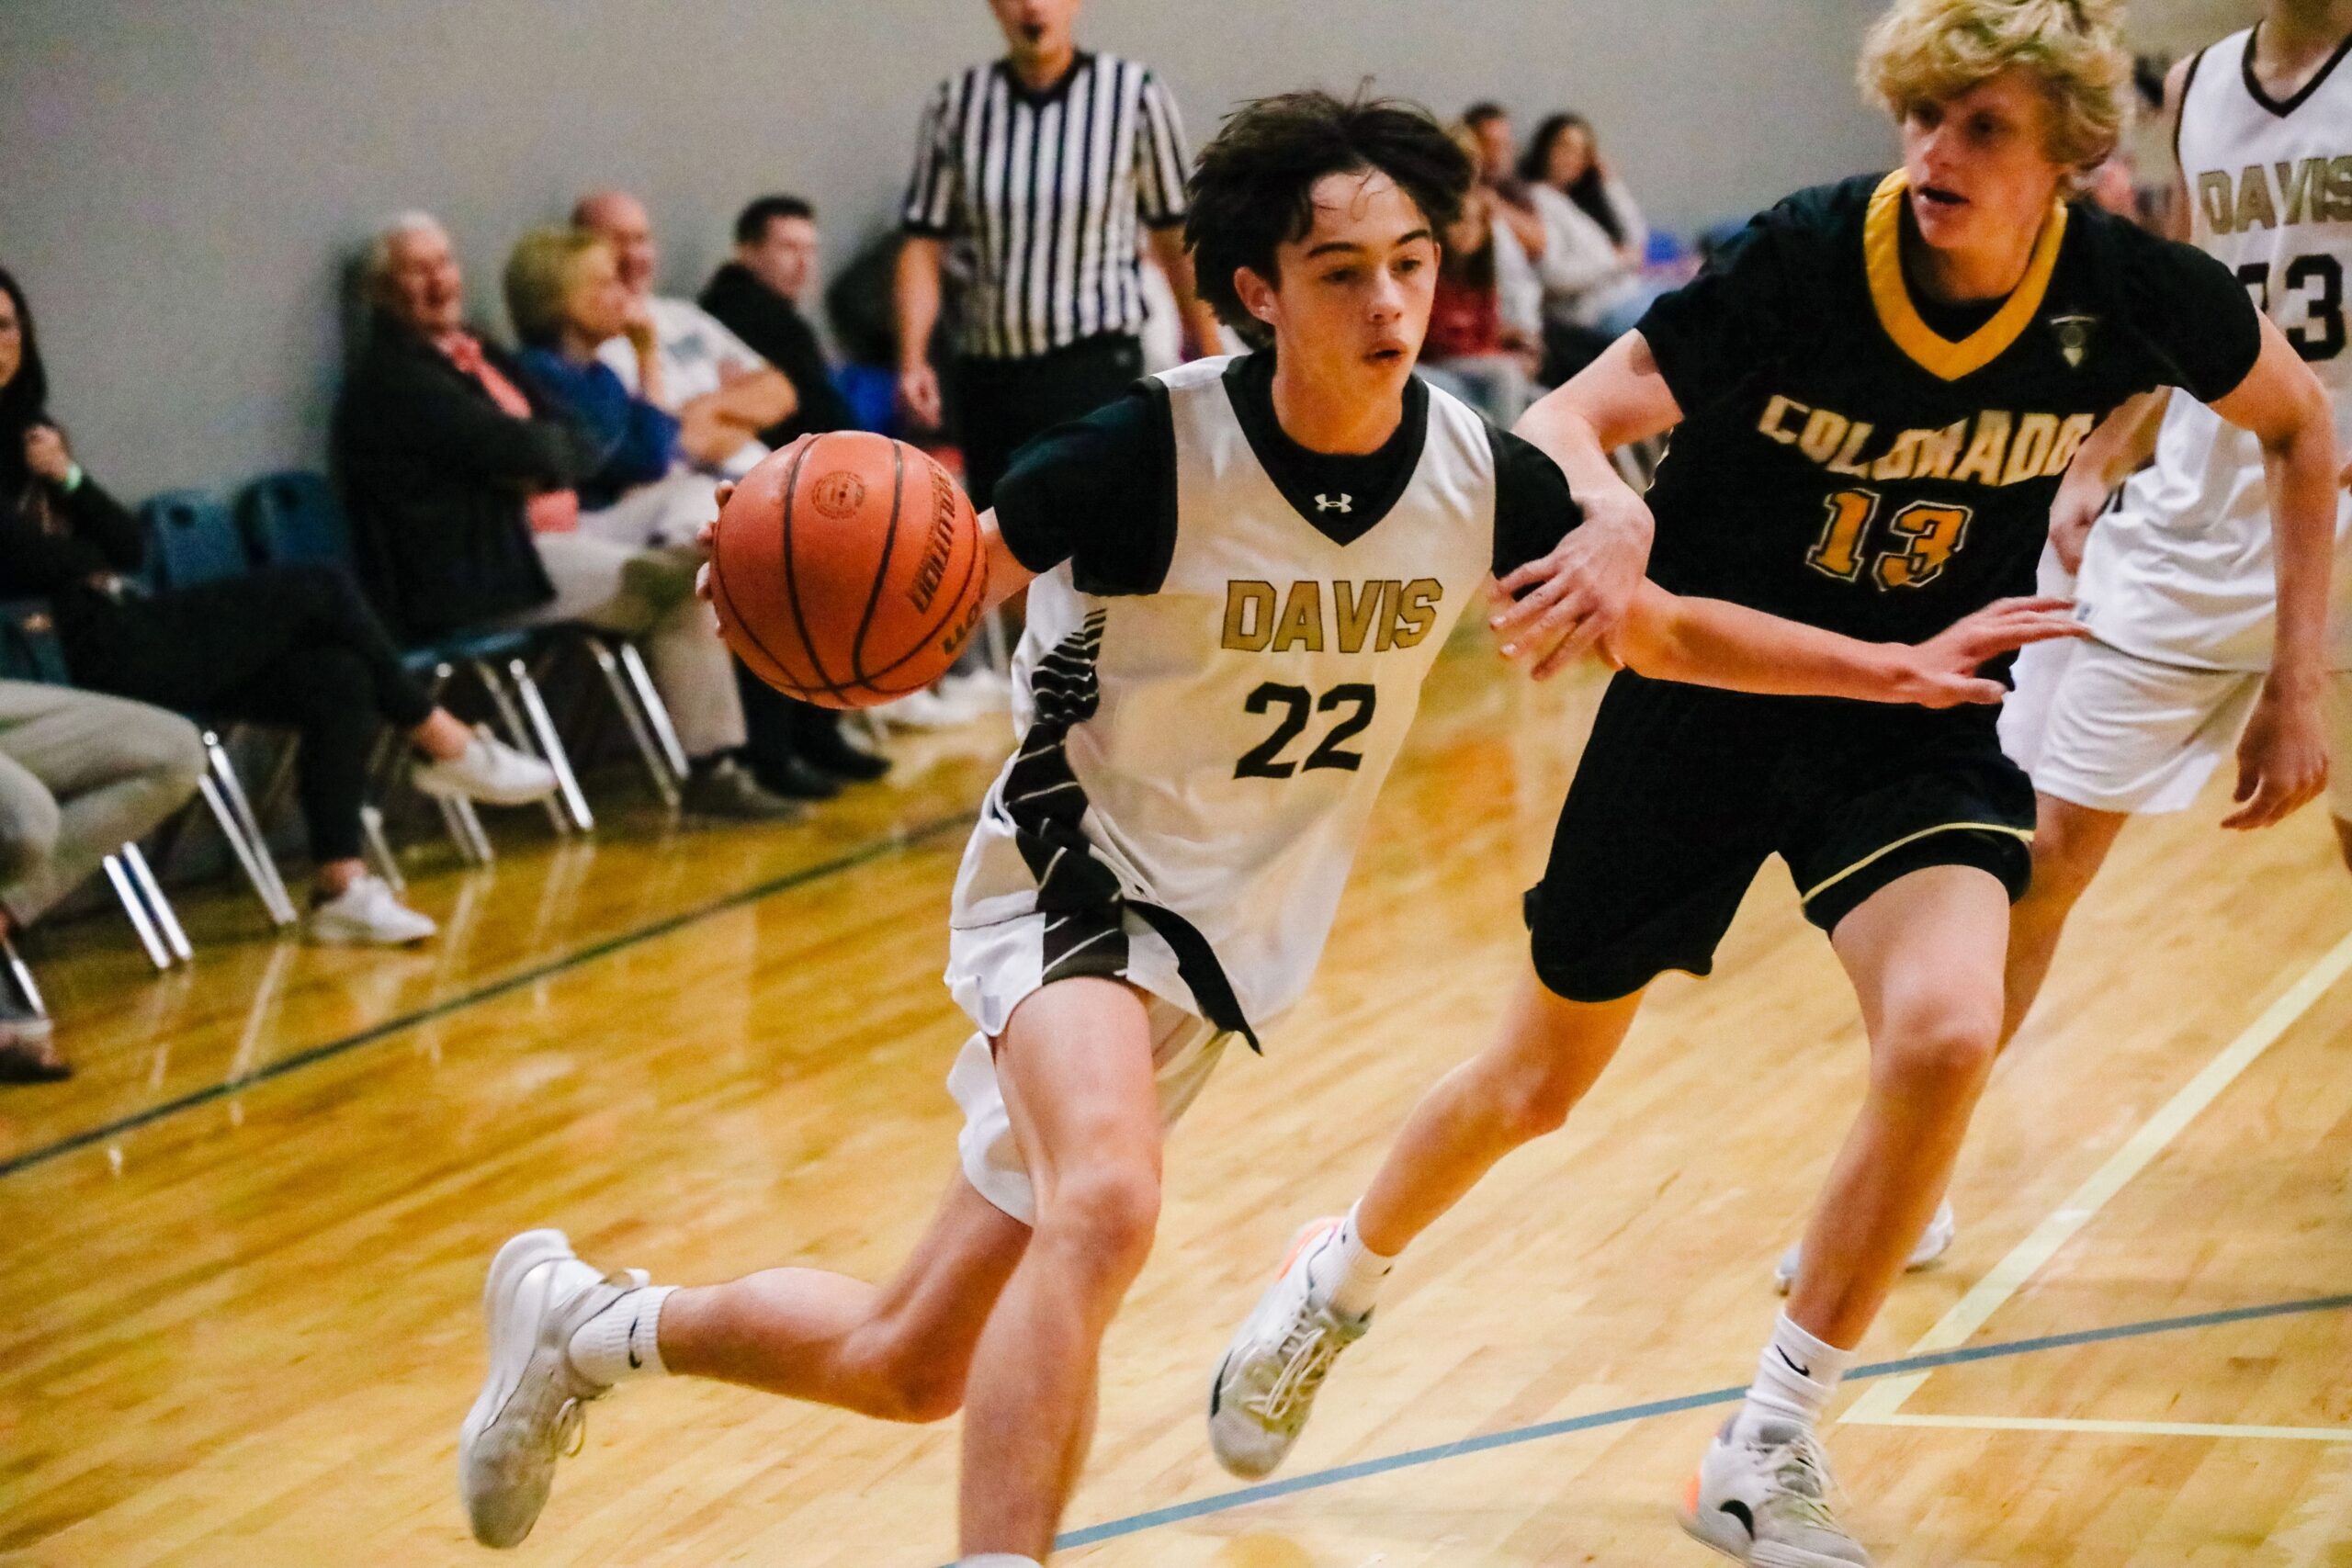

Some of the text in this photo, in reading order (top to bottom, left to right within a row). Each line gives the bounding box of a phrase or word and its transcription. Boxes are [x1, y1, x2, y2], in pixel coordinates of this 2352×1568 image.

[2198, 154, 2352, 235] DAVIS
[1804, 488, 1973, 592] 13
[1221, 578, 1444, 653] DAVIS
[1232, 682, 1376, 780] 22
